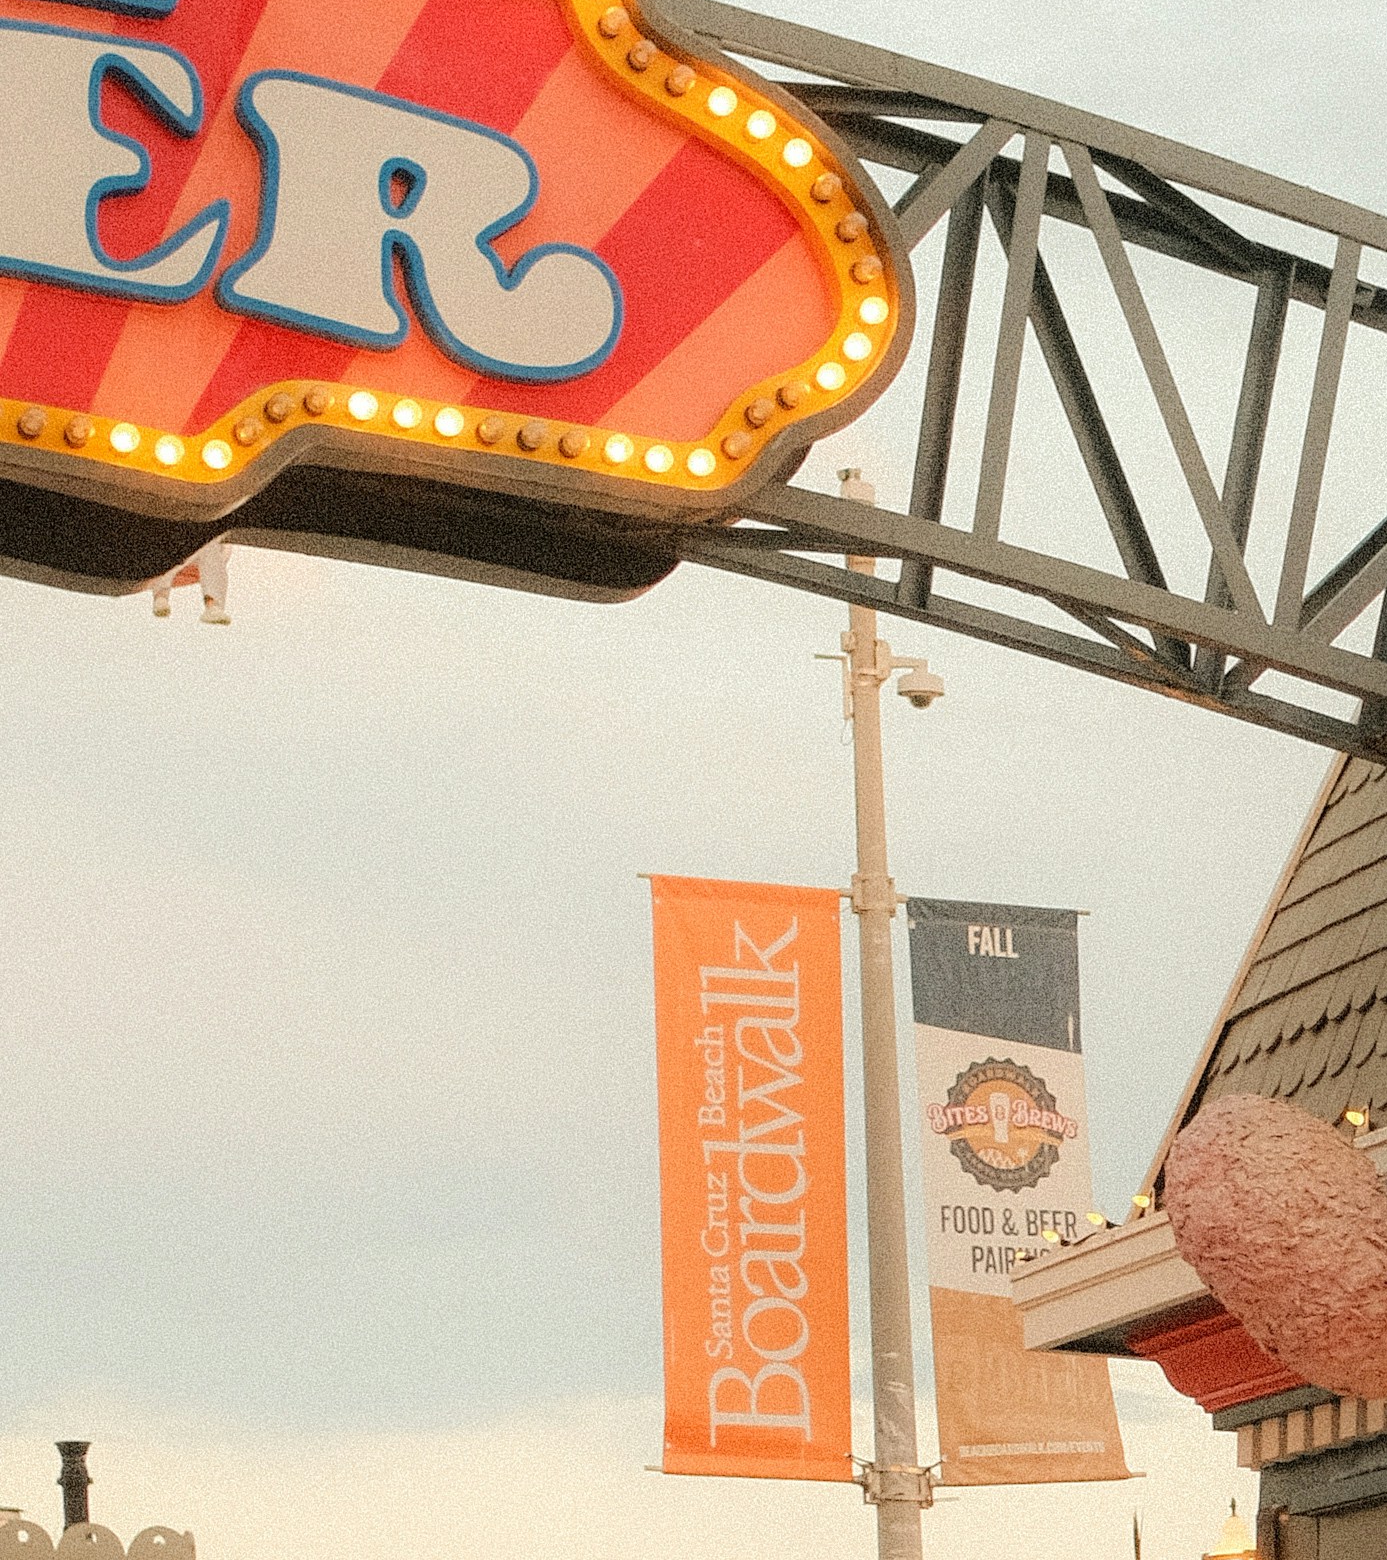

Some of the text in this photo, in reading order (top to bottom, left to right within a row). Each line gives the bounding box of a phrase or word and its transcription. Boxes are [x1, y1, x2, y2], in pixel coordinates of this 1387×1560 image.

[966, 924, 1020, 960] FALL
[693, 1022, 734, 1361] Santa Cruz Beach
[700, 915, 813, 1448] Boardwalk
[940, 1204, 1079, 1239] FOOD & BEER
